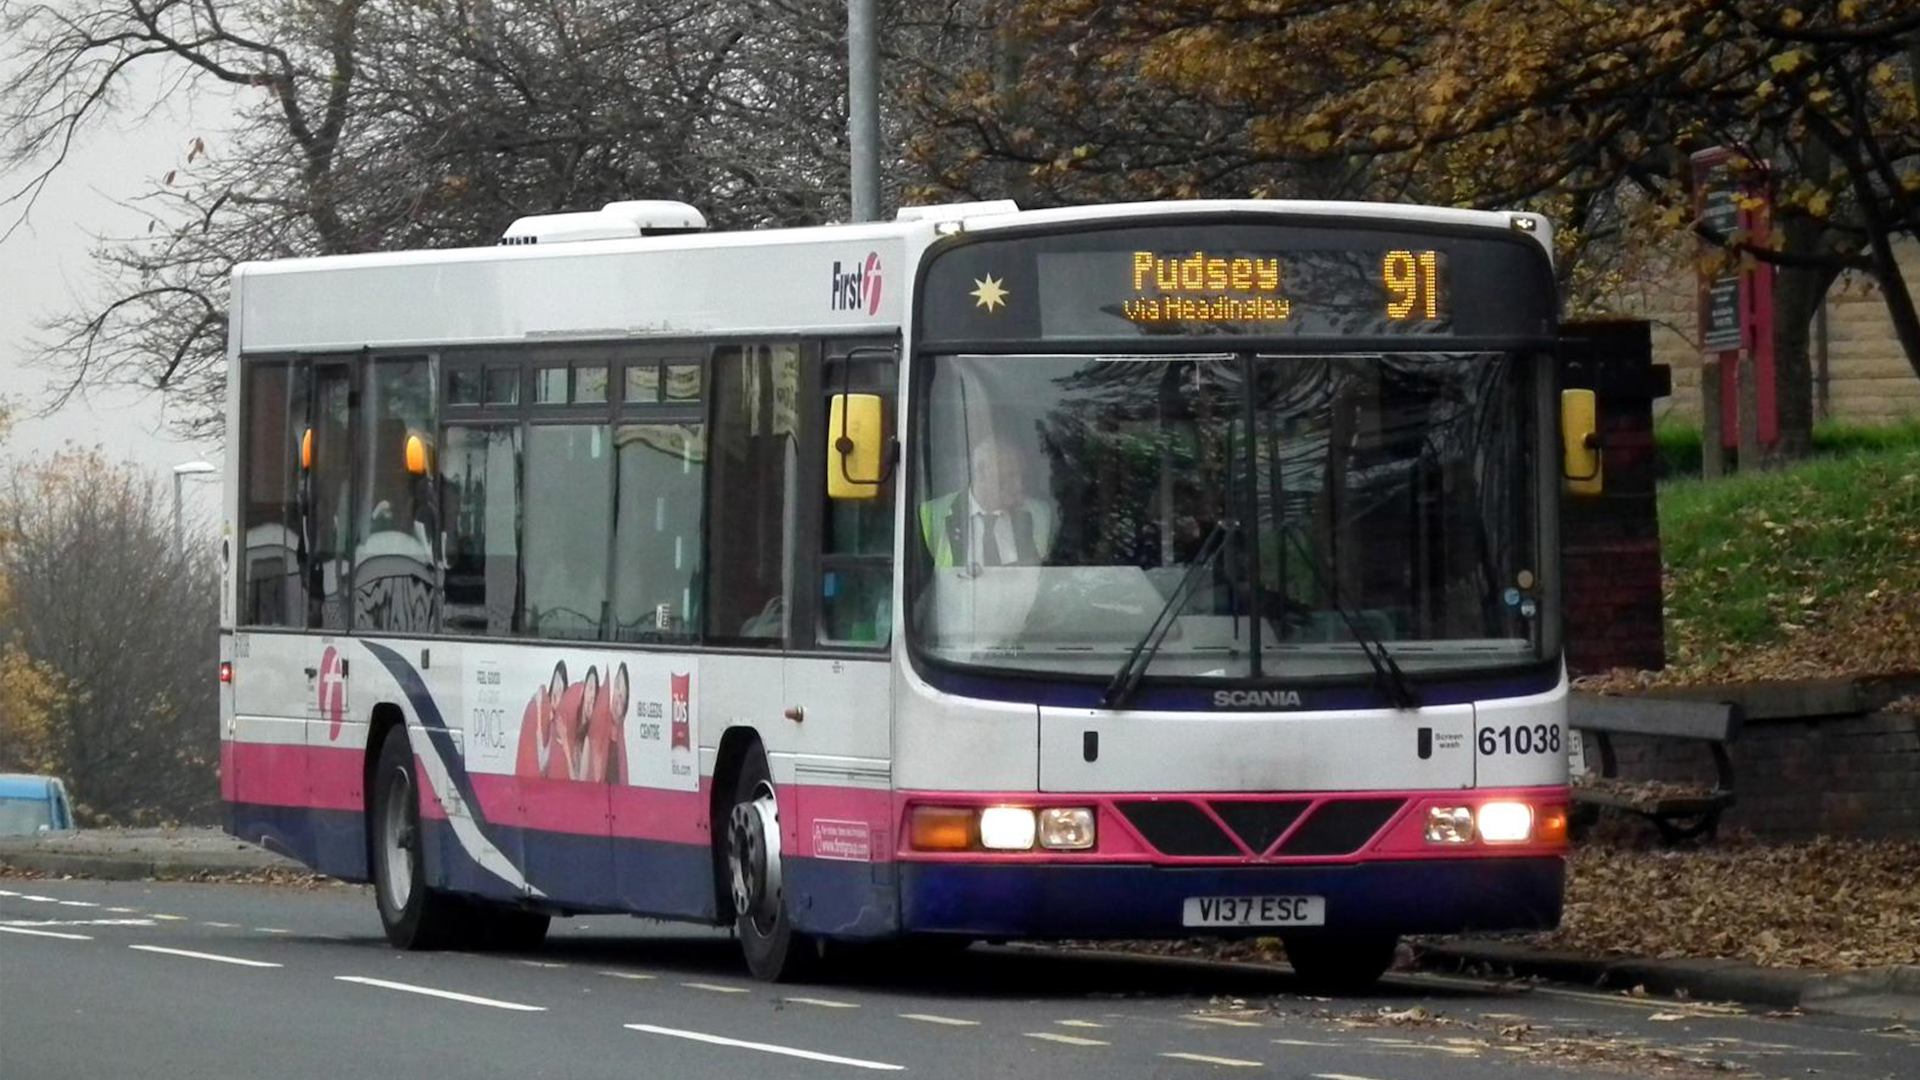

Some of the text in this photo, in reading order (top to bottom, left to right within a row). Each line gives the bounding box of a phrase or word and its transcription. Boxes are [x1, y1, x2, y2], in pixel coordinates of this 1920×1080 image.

[832, 261, 862, 310] First
[1133, 251, 1279, 290] Pudsey
[1383, 250, 1437, 319] 91
[1124, 296, 1160, 320] via
[1213, 690, 1301, 707] SCANIA
[1478, 724, 1561, 756] 61038
[1200, 898, 1308, 922] V137 ESC
